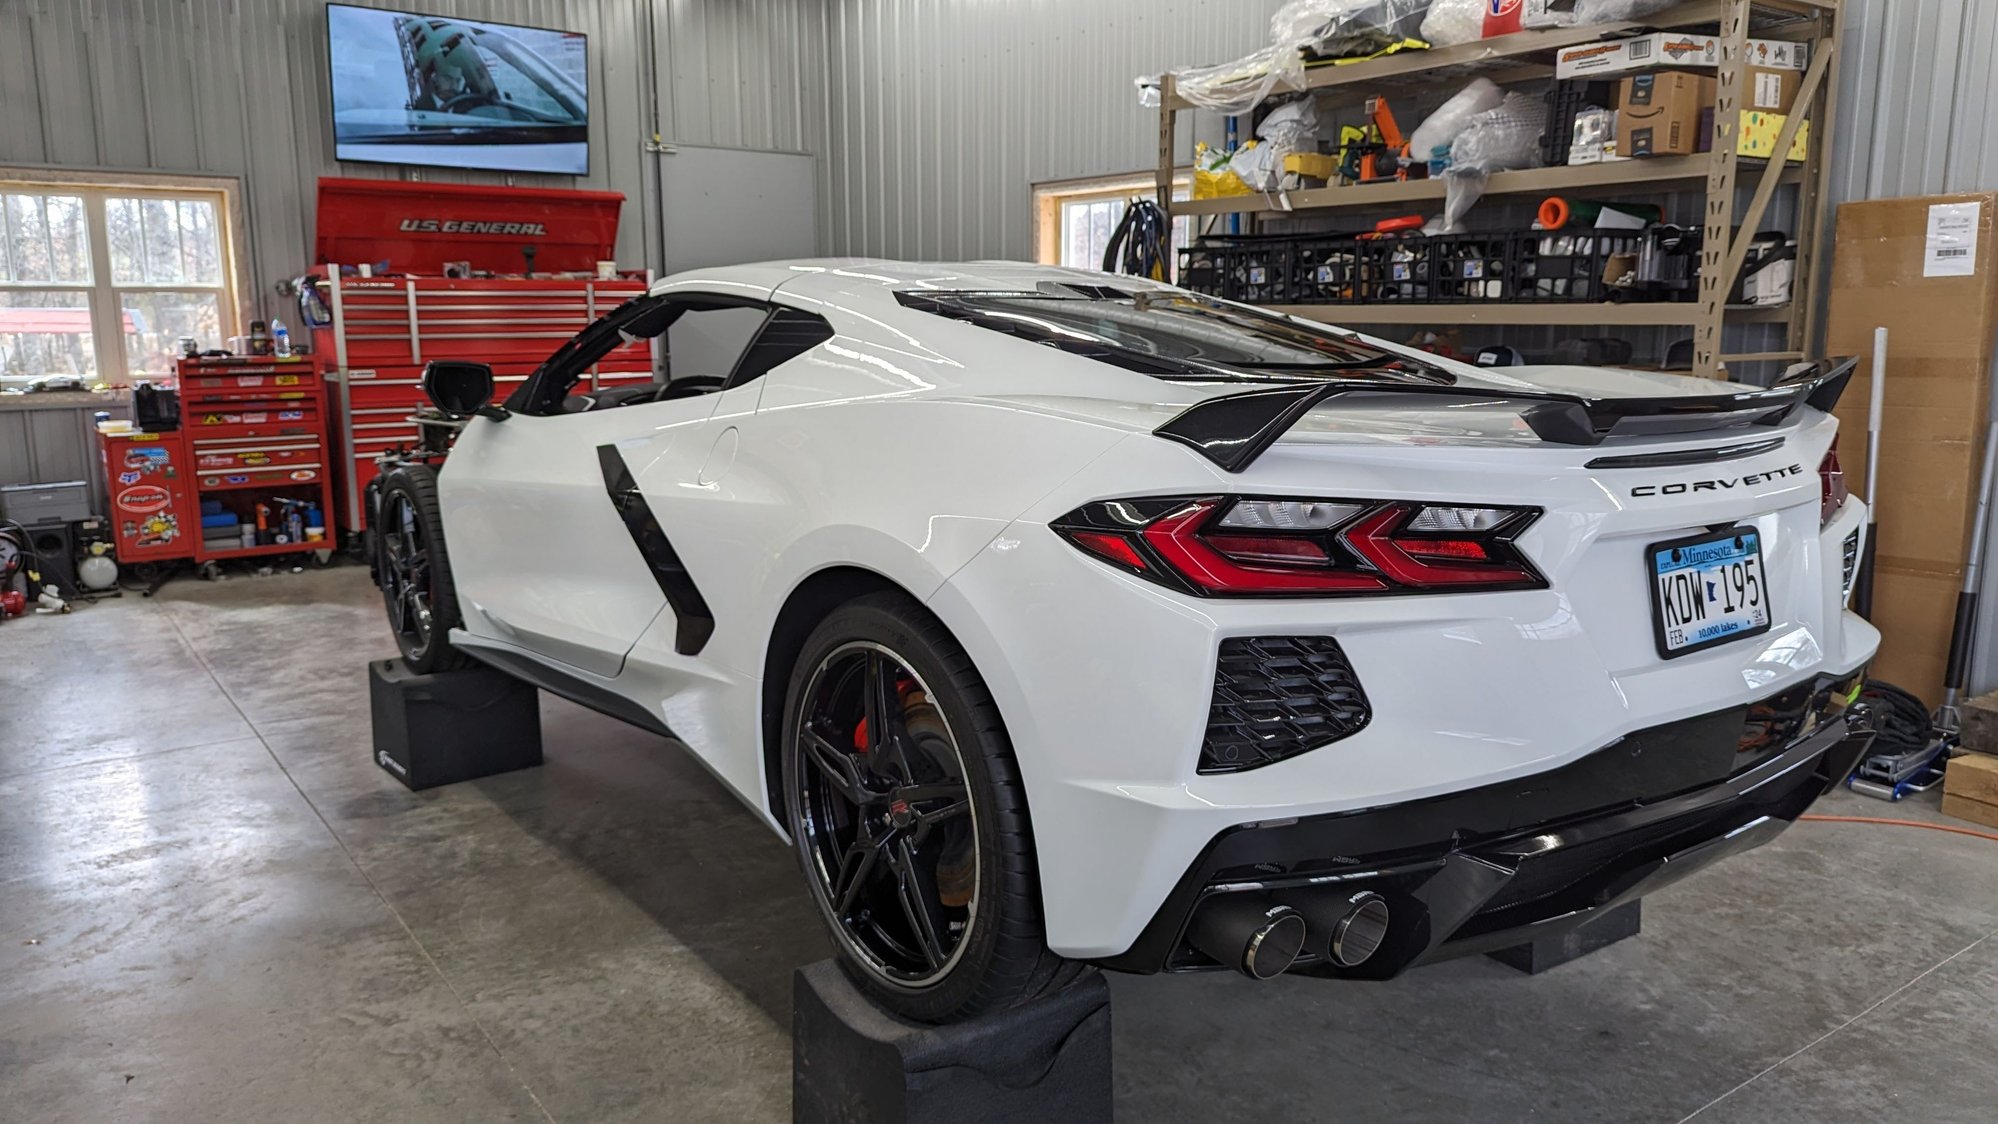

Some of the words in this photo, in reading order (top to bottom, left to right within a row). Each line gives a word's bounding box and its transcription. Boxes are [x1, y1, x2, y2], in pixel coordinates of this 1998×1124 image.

[441, 220, 548, 235] GENERAL
[1631, 463, 1803, 498] CORVETTE
[1682, 545, 1732, 565] Minnesota
[1662, 569, 1706, 628] KDW
[1720, 559, 1759, 614] 195
[1669, 628, 1684, 646] FEB
[1698, 624, 1720, 640] 10,000
[1720, 621, 1738, 635] lakes
